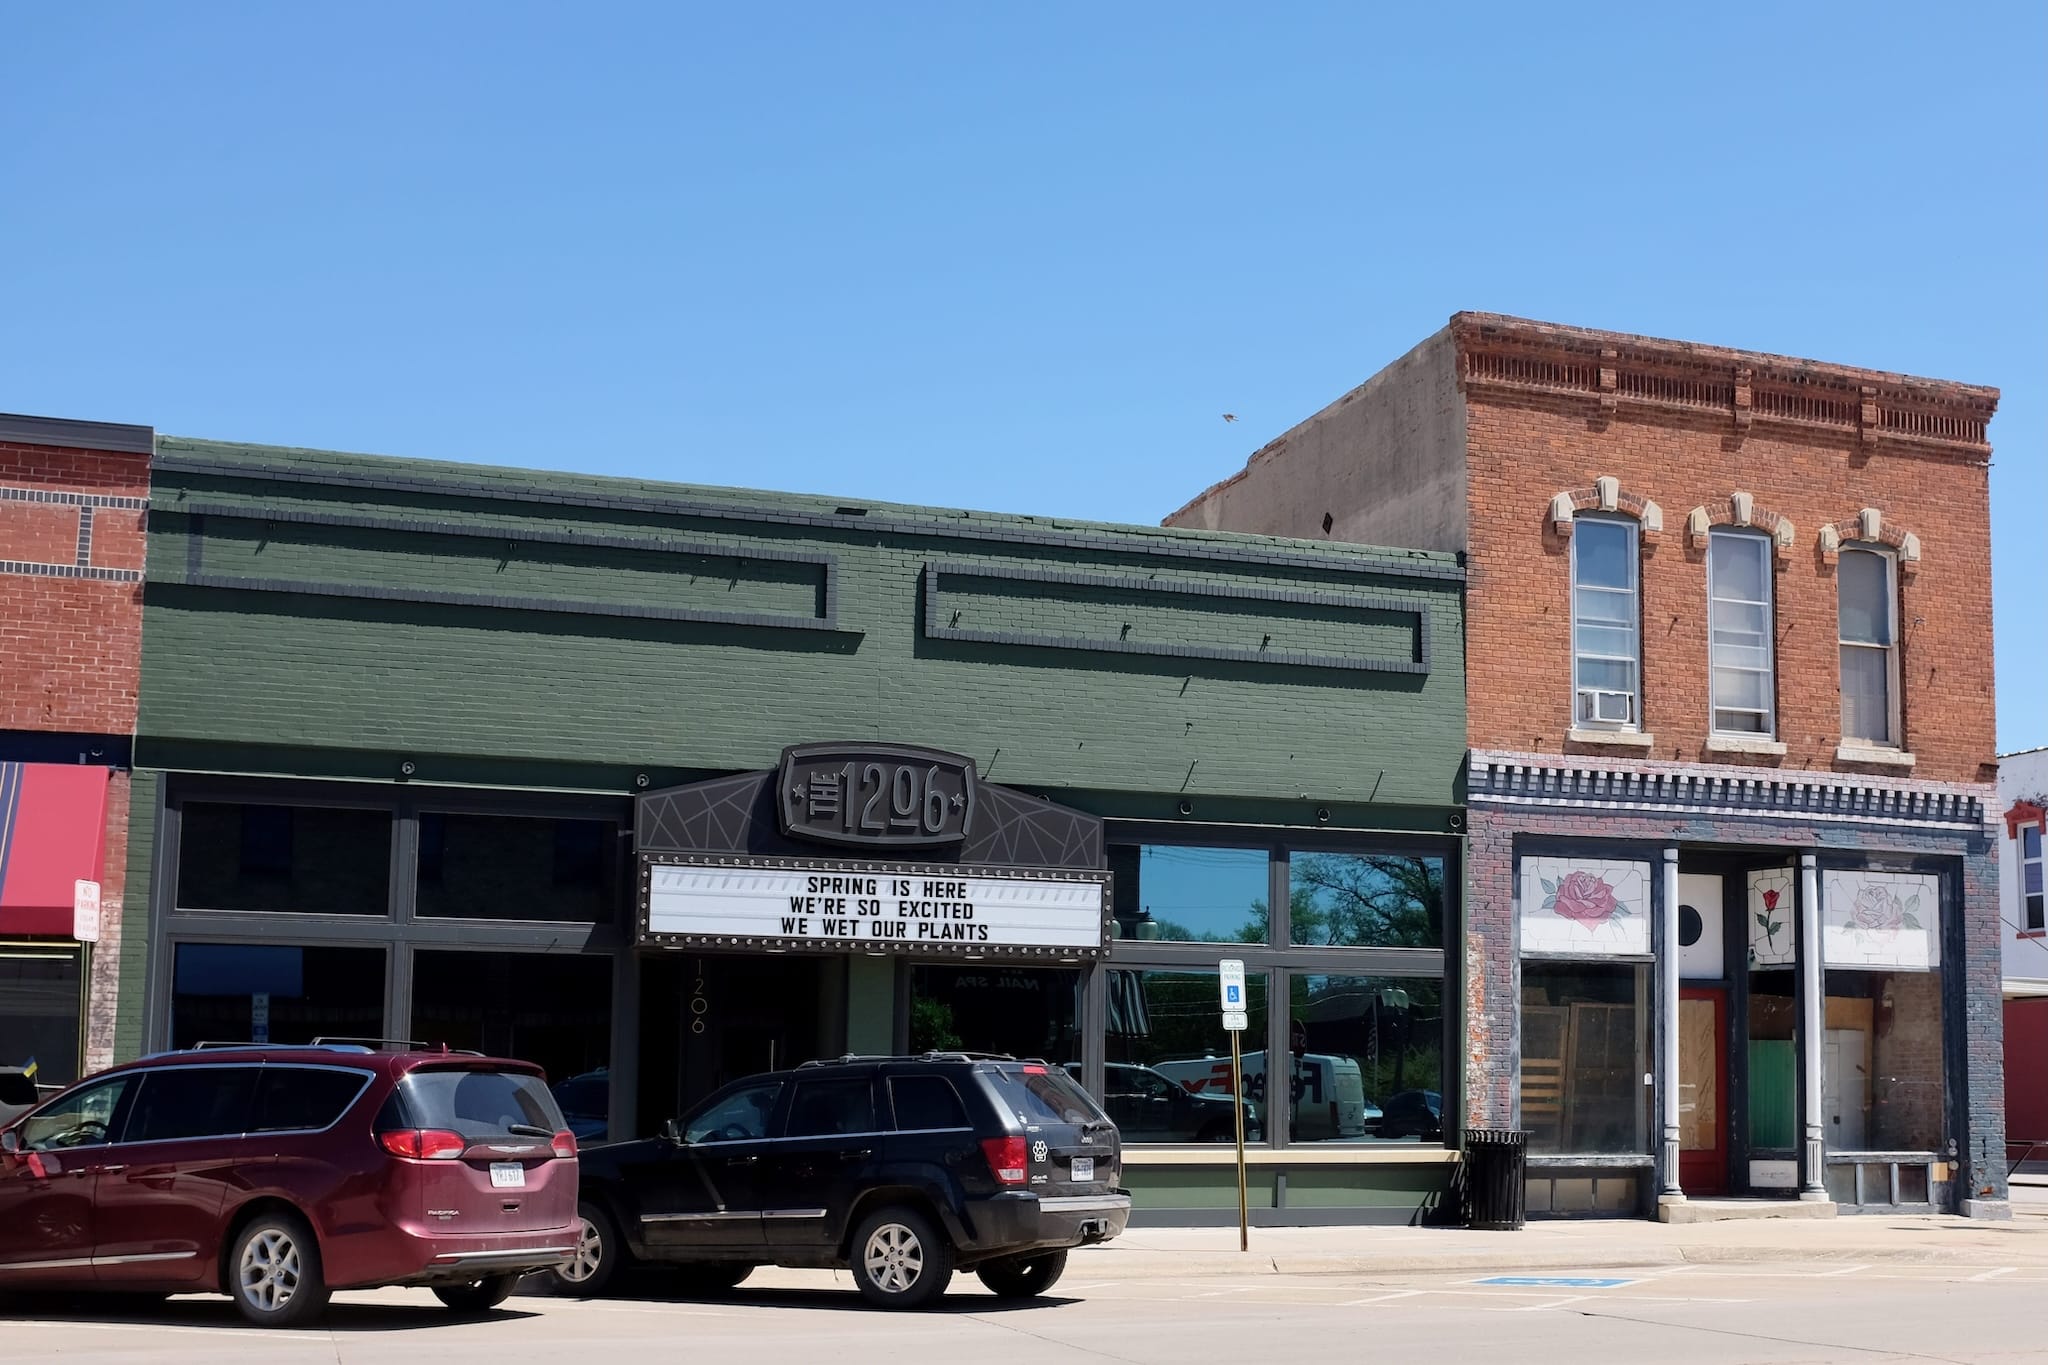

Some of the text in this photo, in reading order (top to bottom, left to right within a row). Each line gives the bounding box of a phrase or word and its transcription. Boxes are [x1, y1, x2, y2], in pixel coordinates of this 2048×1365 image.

[809, 761, 949, 833] THE 1206
[807, 876, 967, 899] SPRING IS HERE
[789, 896, 974, 920] WE'RE SO EXCITED
[781, 917, 989, 941] WE WET OUR PLANTS
[691, 959, 708, 1034] 1206
